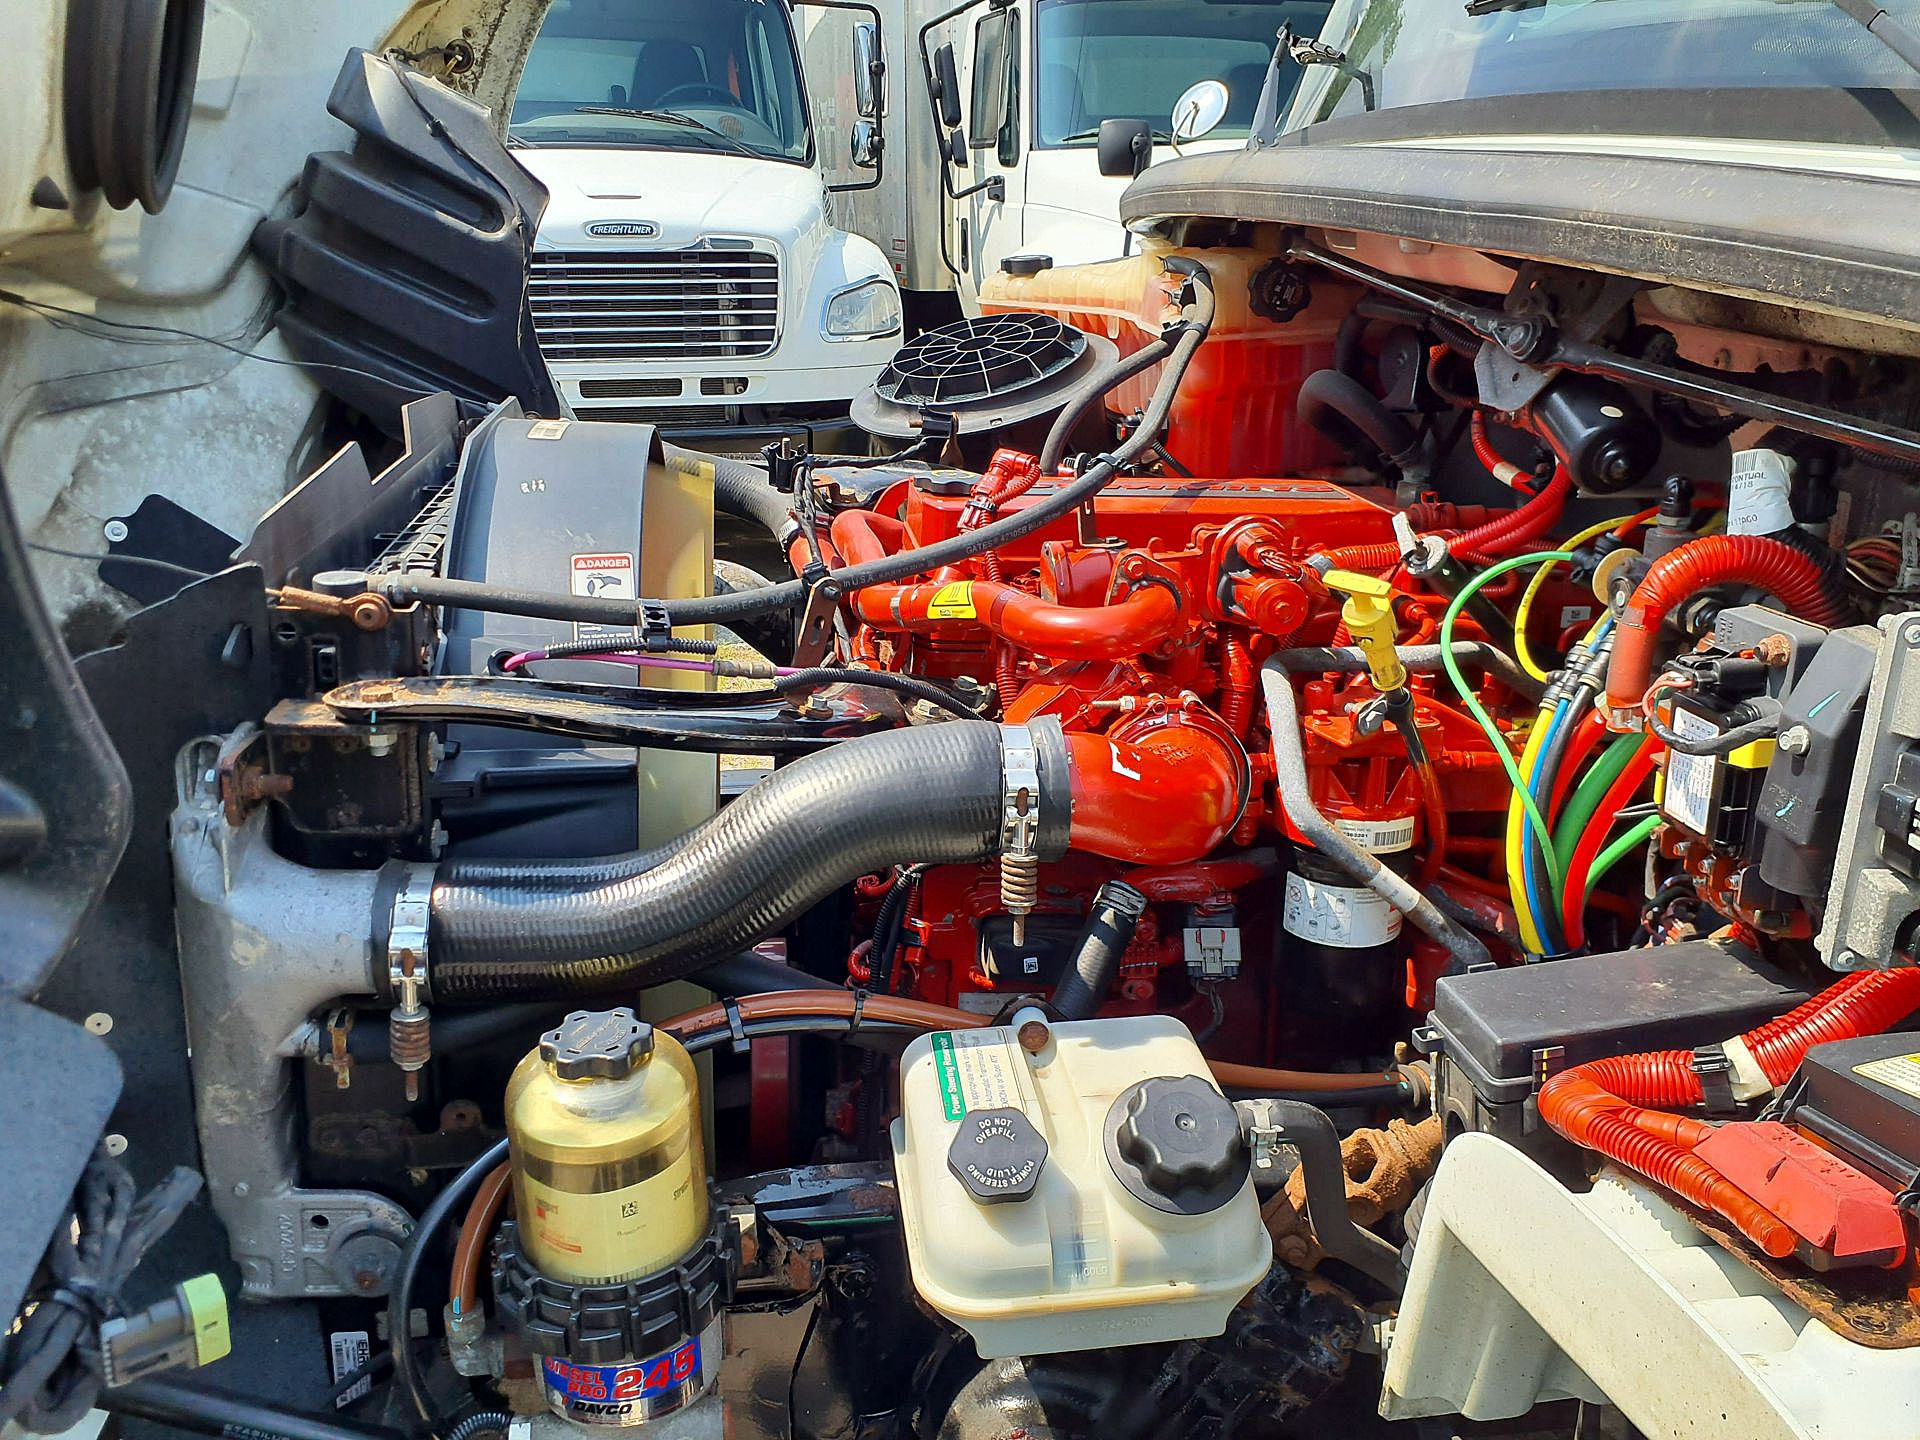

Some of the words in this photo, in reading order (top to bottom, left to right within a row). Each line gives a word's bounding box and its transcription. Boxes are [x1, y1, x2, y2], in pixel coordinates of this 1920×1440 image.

[593, 225, 651, 234] FREIGHTLINER
[587, 559, 629, 568] DANGER
[938, 1036, 951, 1065] Reservoir
[944, 1065, 958, 1092] Steering
[949, 1093, 961, 1114] Power
[979, 1119, 991, 1129] DO
[994, 1117, 1012, 1127] NOT
[976, 1127, 1016, 1144] OVERFILL
[967, 1164, 1008, 1187] STEERING
[986, 1165, 1017, 1178] FLUID
[1010, 1160, 1034, 1185] POWER
[544, 1356, 605, 1385] DIESEL
[613, 1343, 695, 1400] 245
[568, 1379, 607, 1399] PRO
